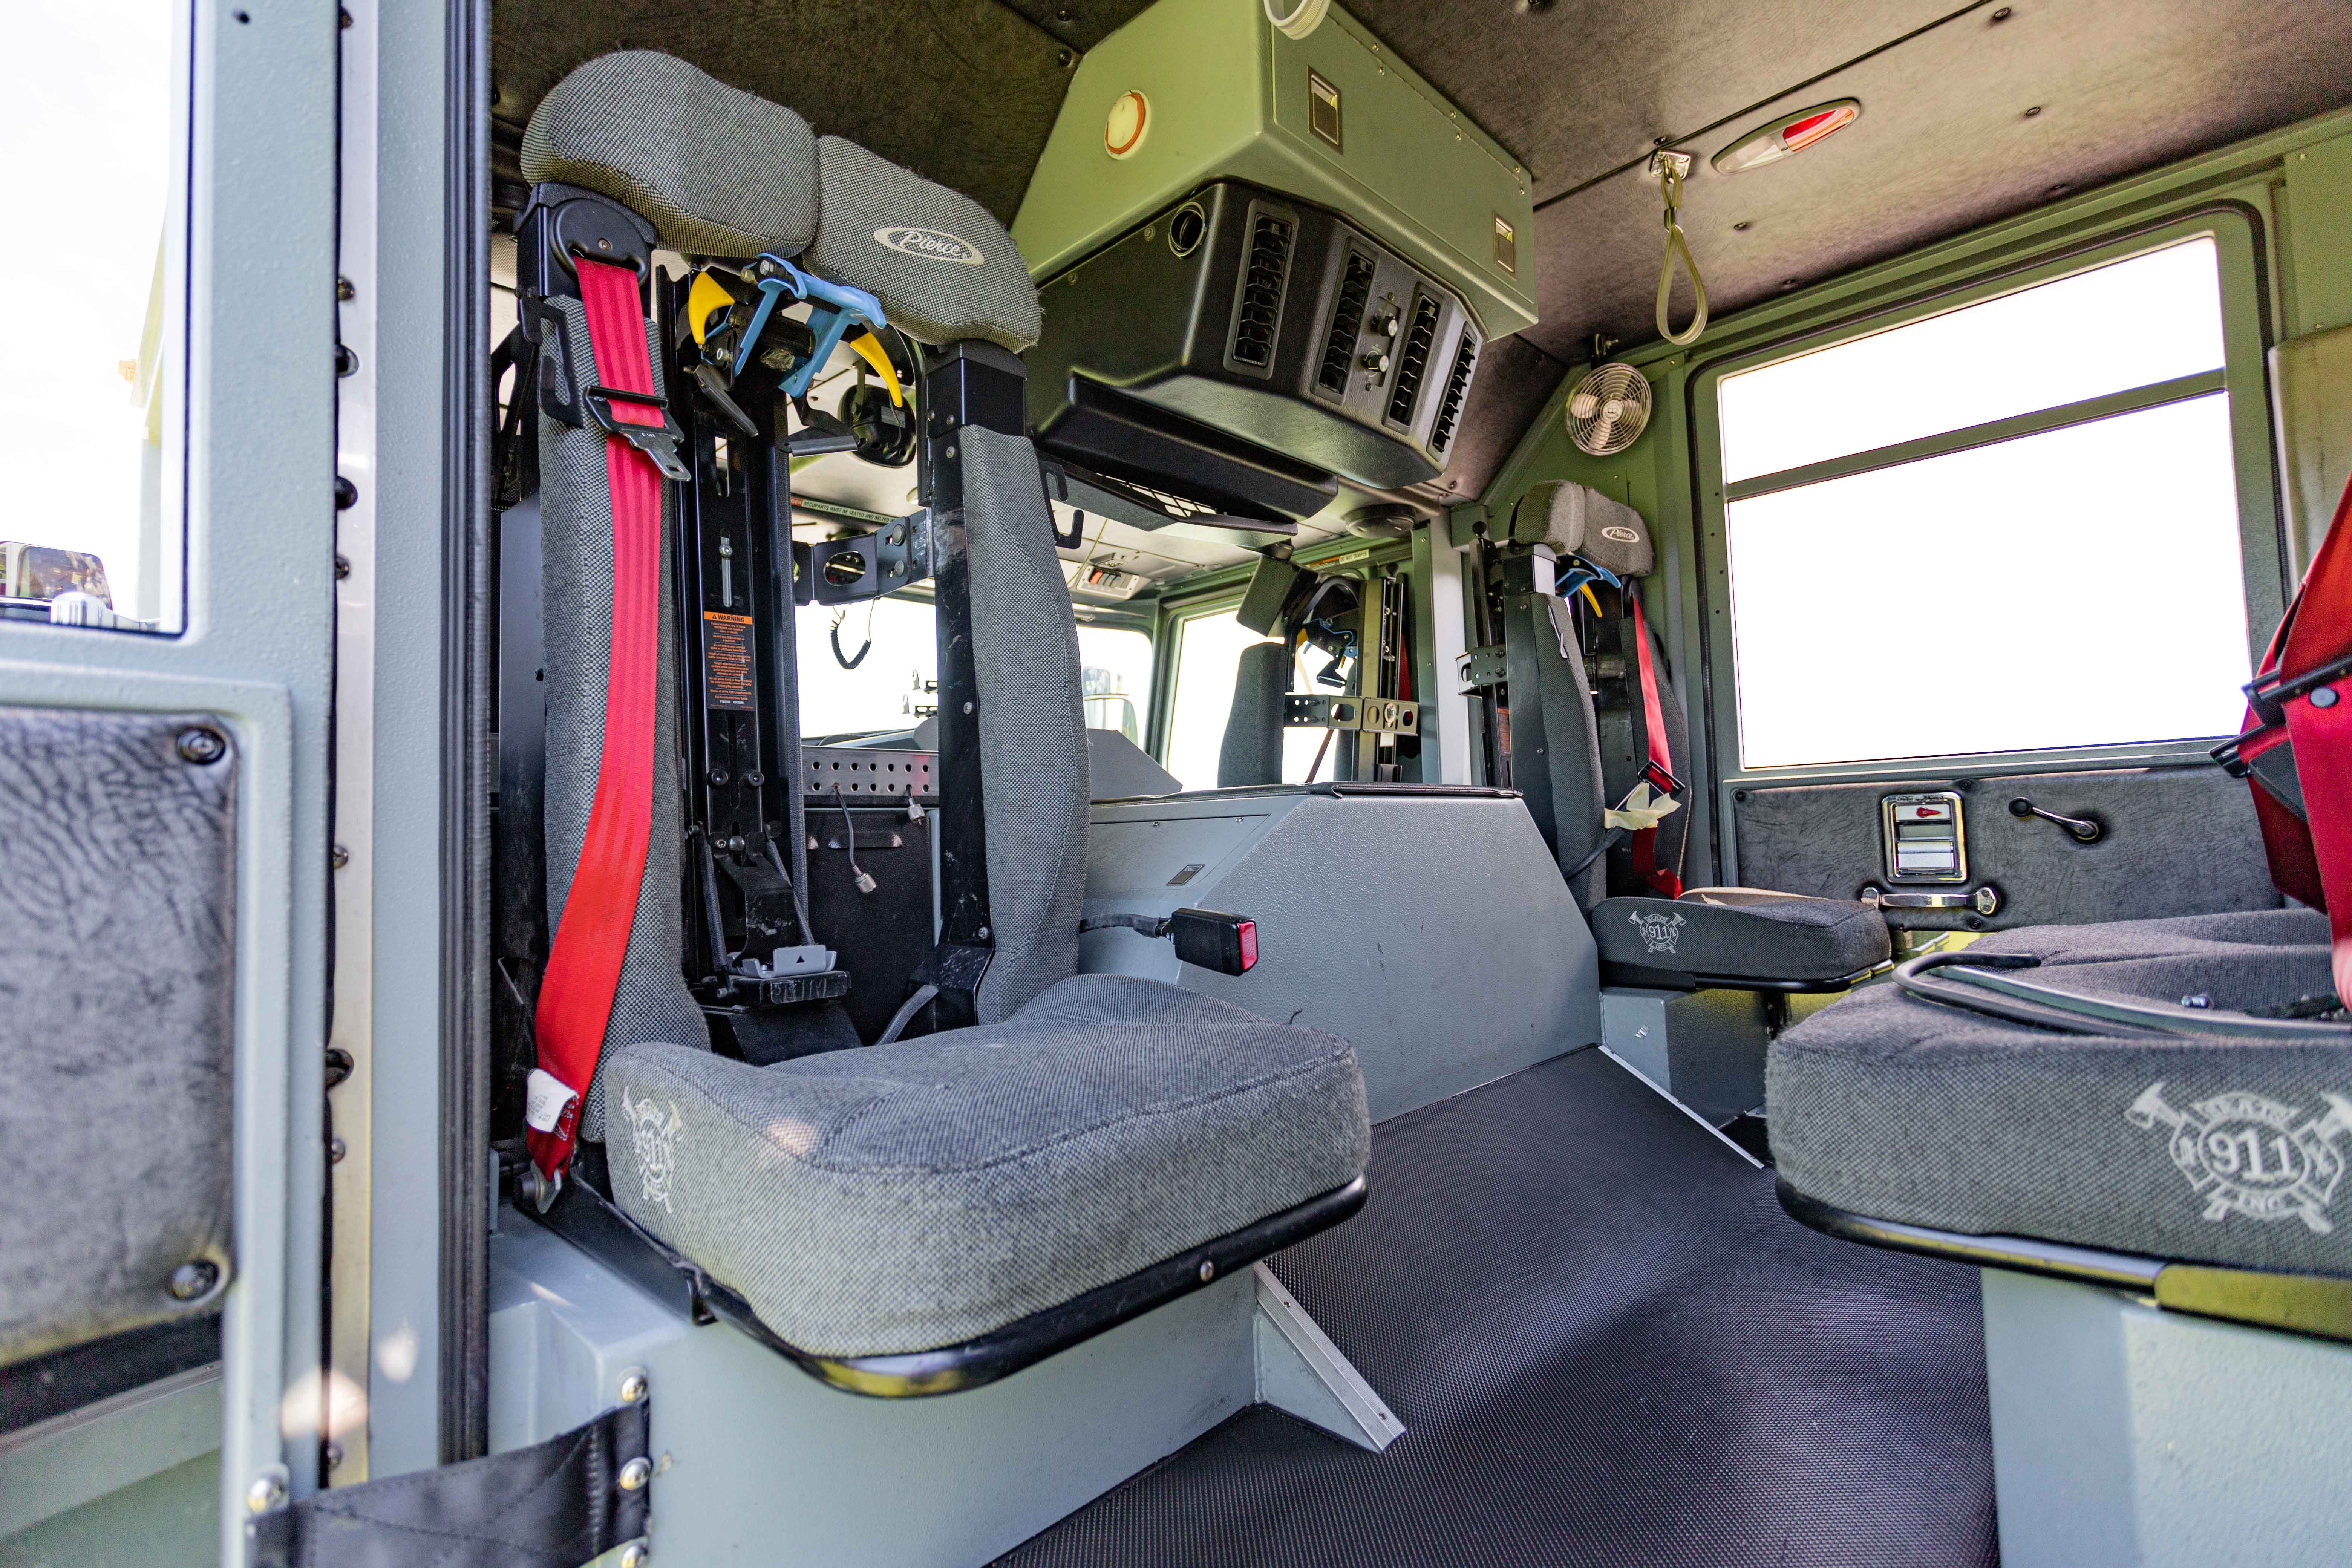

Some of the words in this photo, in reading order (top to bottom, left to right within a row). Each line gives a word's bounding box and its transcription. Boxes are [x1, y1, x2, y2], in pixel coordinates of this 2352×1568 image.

[900, 231, 962, 256] Pierce
[803, 501, 829, 510] OCCUPANTS
[1610, 528, 1632, 539] Pierce
[717, 614, 745, 623] WARNING
[1648, 923, 1669, 940] 911
[1245, 931, 1255, 956] PRESS
[2207, 1129, 2301, 1182] 911
